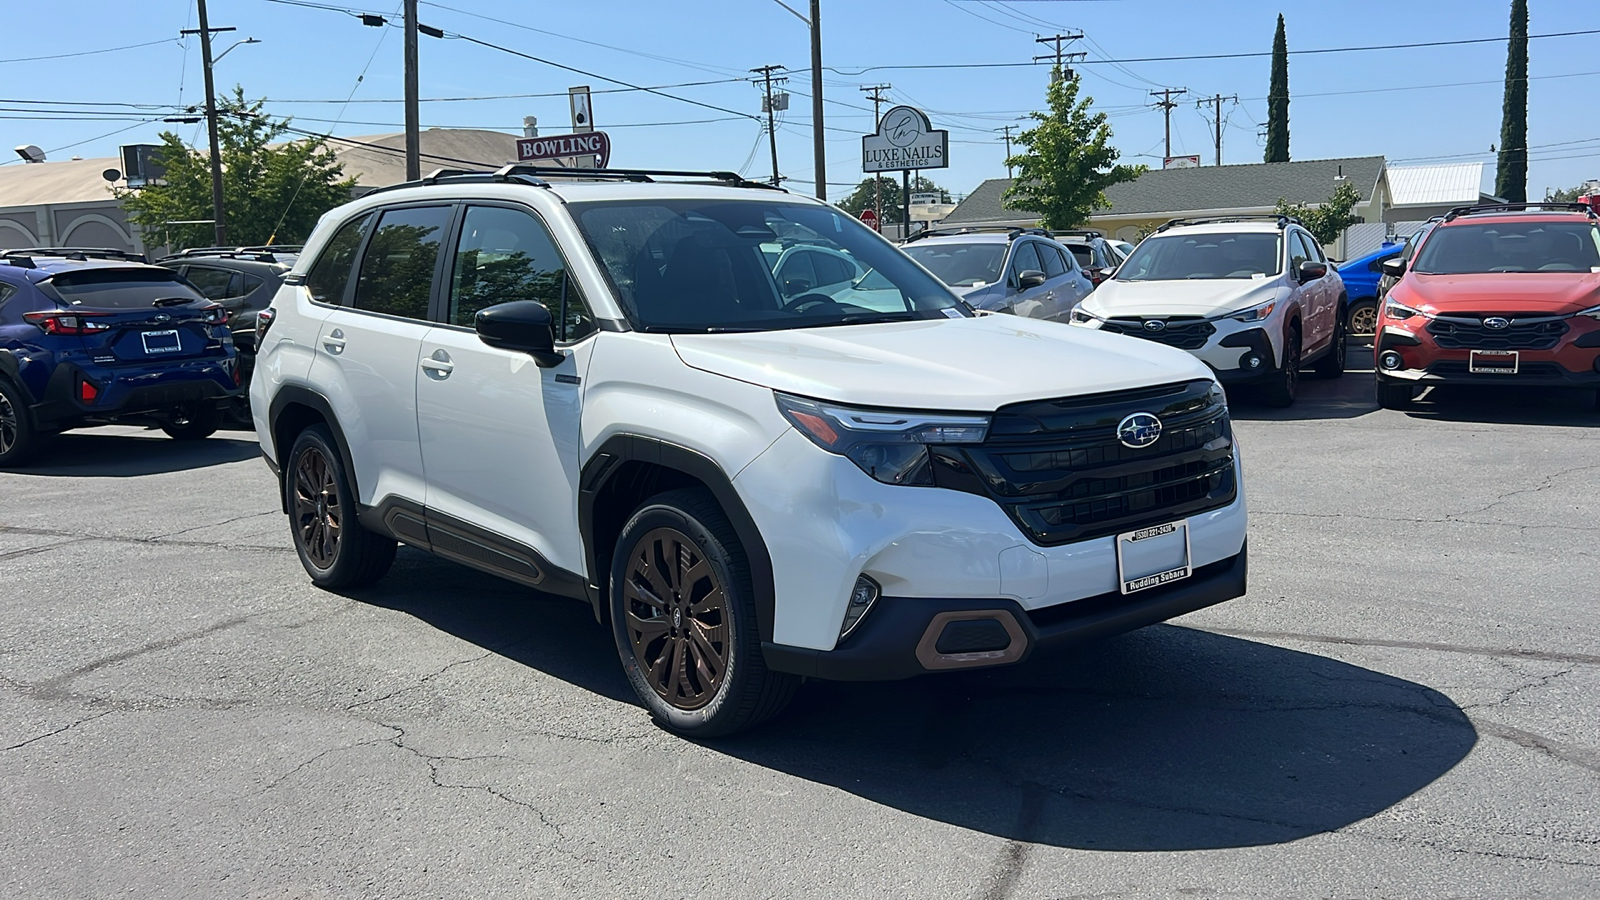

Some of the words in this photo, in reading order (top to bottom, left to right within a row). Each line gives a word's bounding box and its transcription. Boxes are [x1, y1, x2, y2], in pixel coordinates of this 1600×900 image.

[522, 136, 601, 157] BOWLING
[866, 148, 900, 163] LUXE
[902, 145, 942, 159] NAILS
[885, 159, 929, 168] ESTHETICS
[1160, 570, 1184, 581] Subaru
